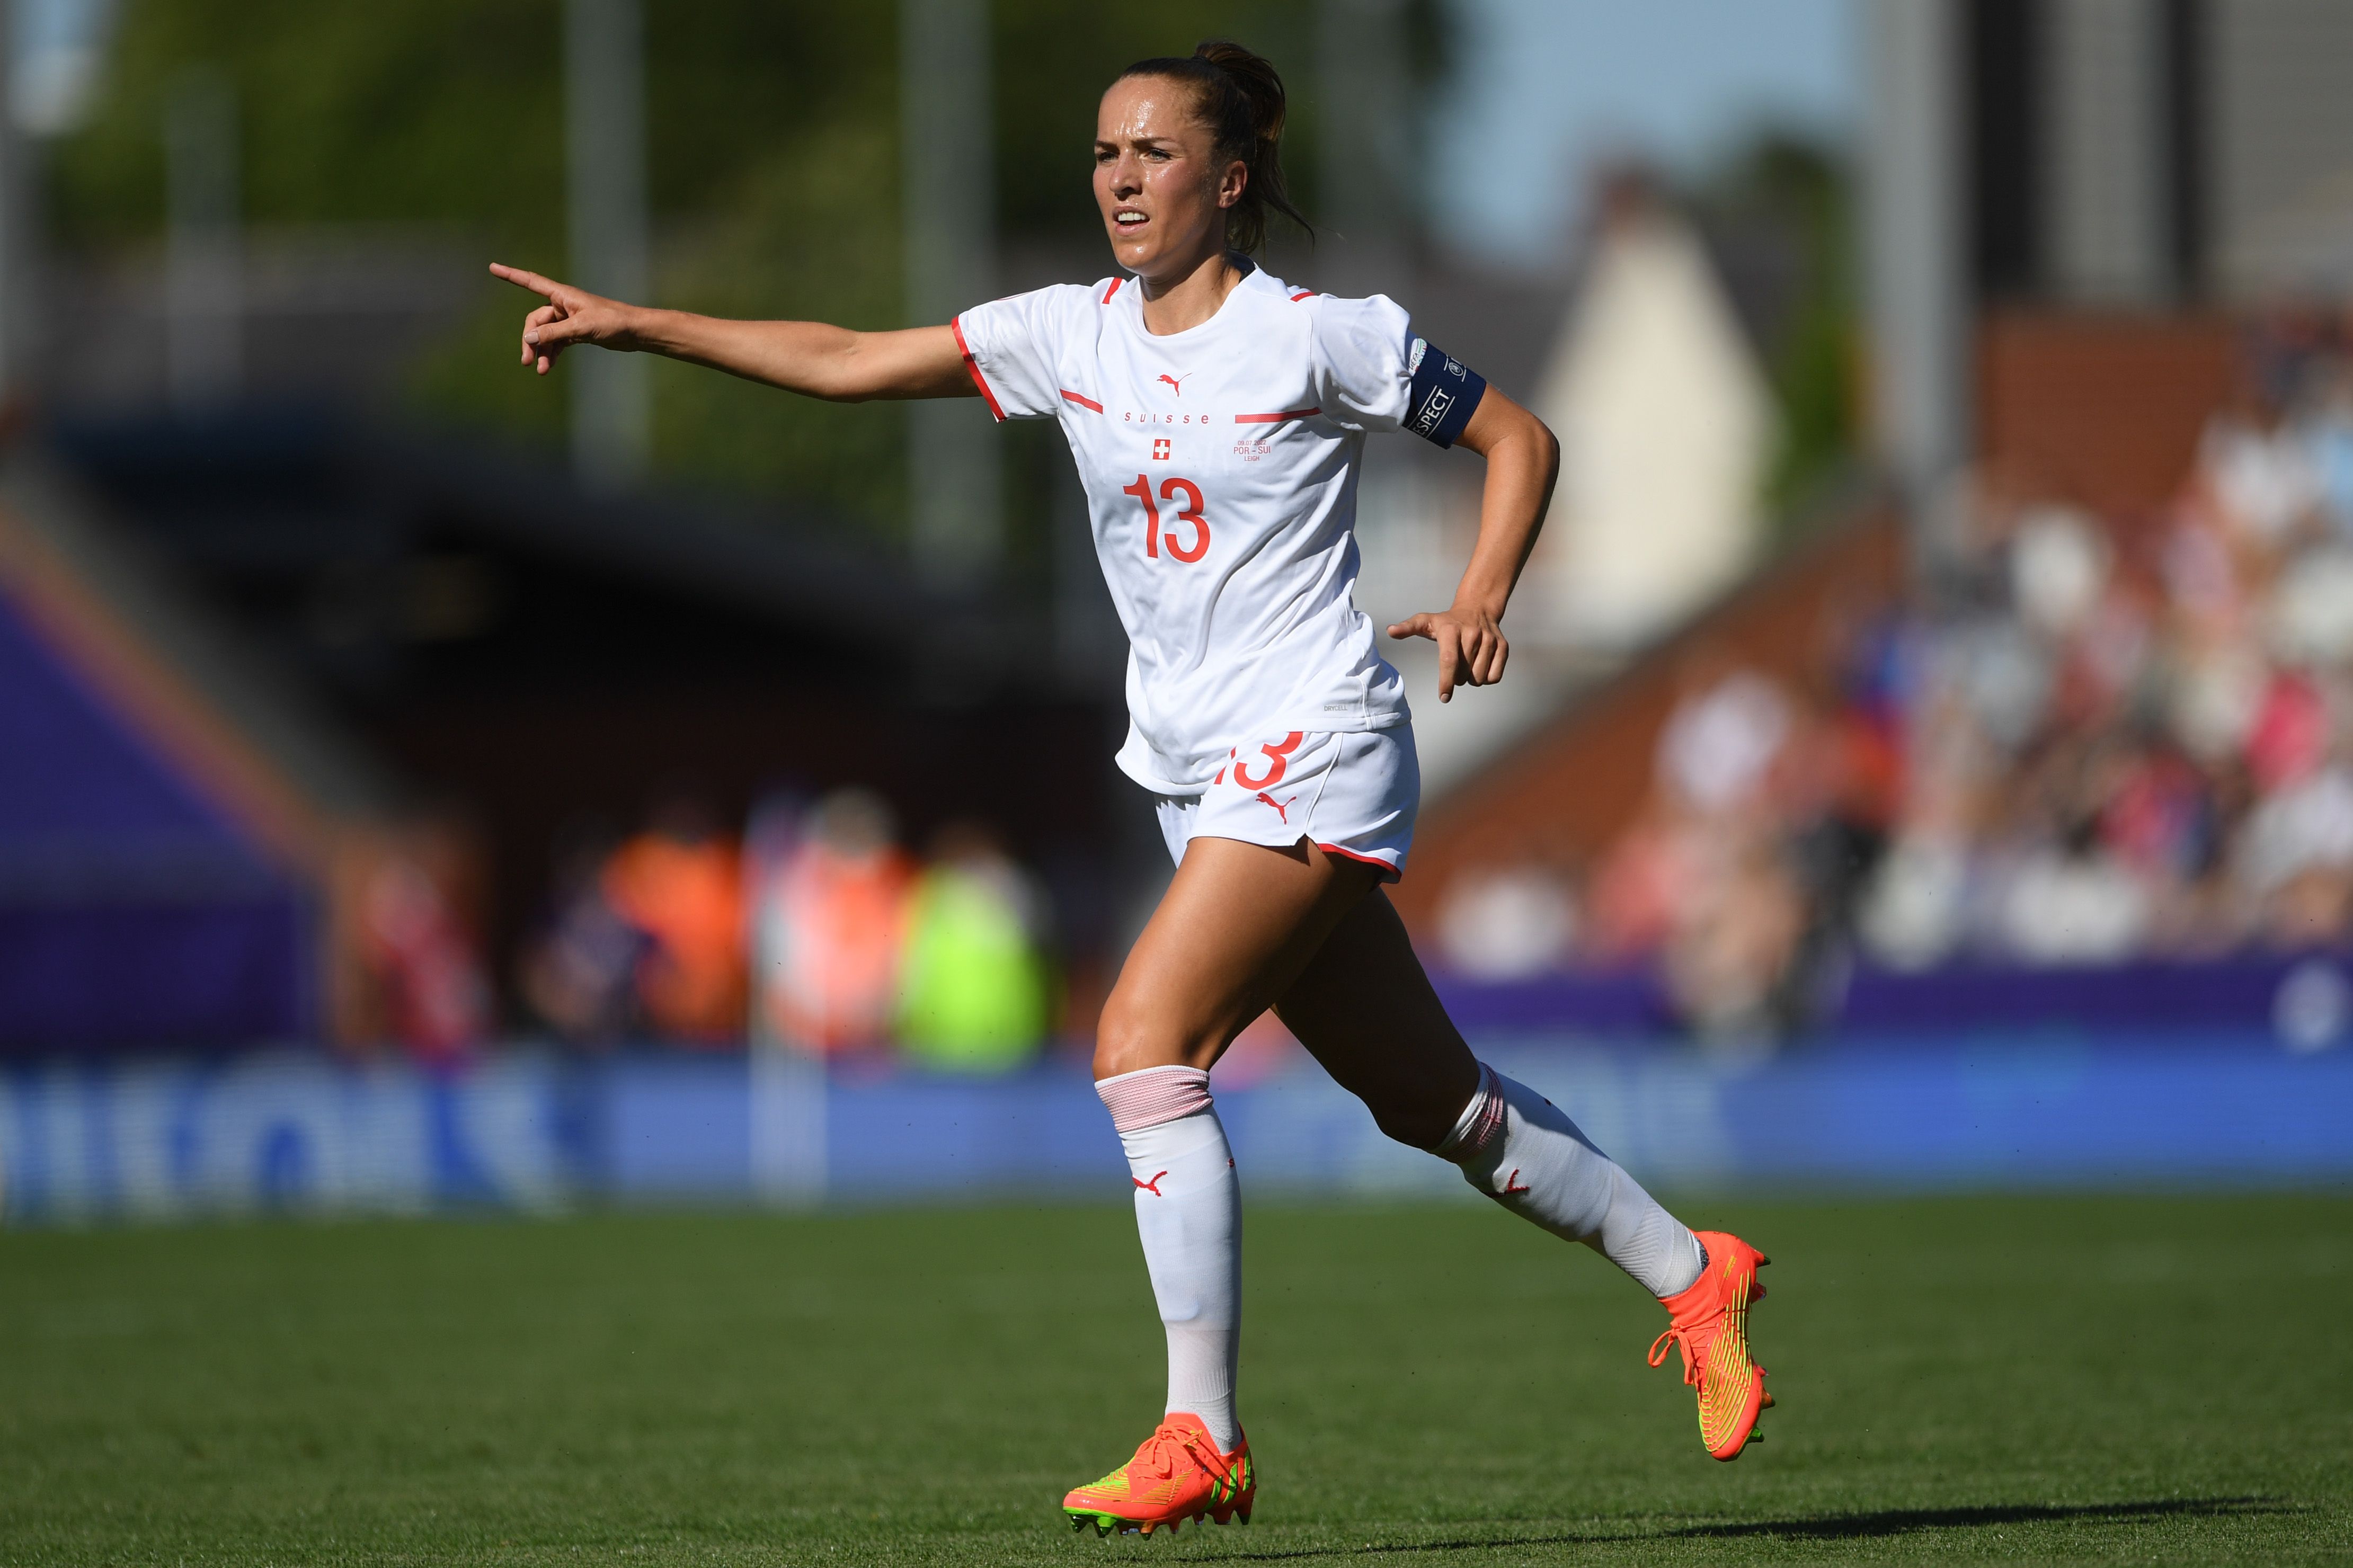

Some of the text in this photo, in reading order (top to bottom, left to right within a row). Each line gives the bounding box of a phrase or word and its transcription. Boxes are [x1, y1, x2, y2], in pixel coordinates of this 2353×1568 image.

[1124, 412, 1209, 424] suisse
[1413, 388, 1449, 435] ESPECT
[1233, 446, 1249, 455] POR
[1258, 446, 1271, 454] SUI
[1123, 473, 1211, 563] 13
